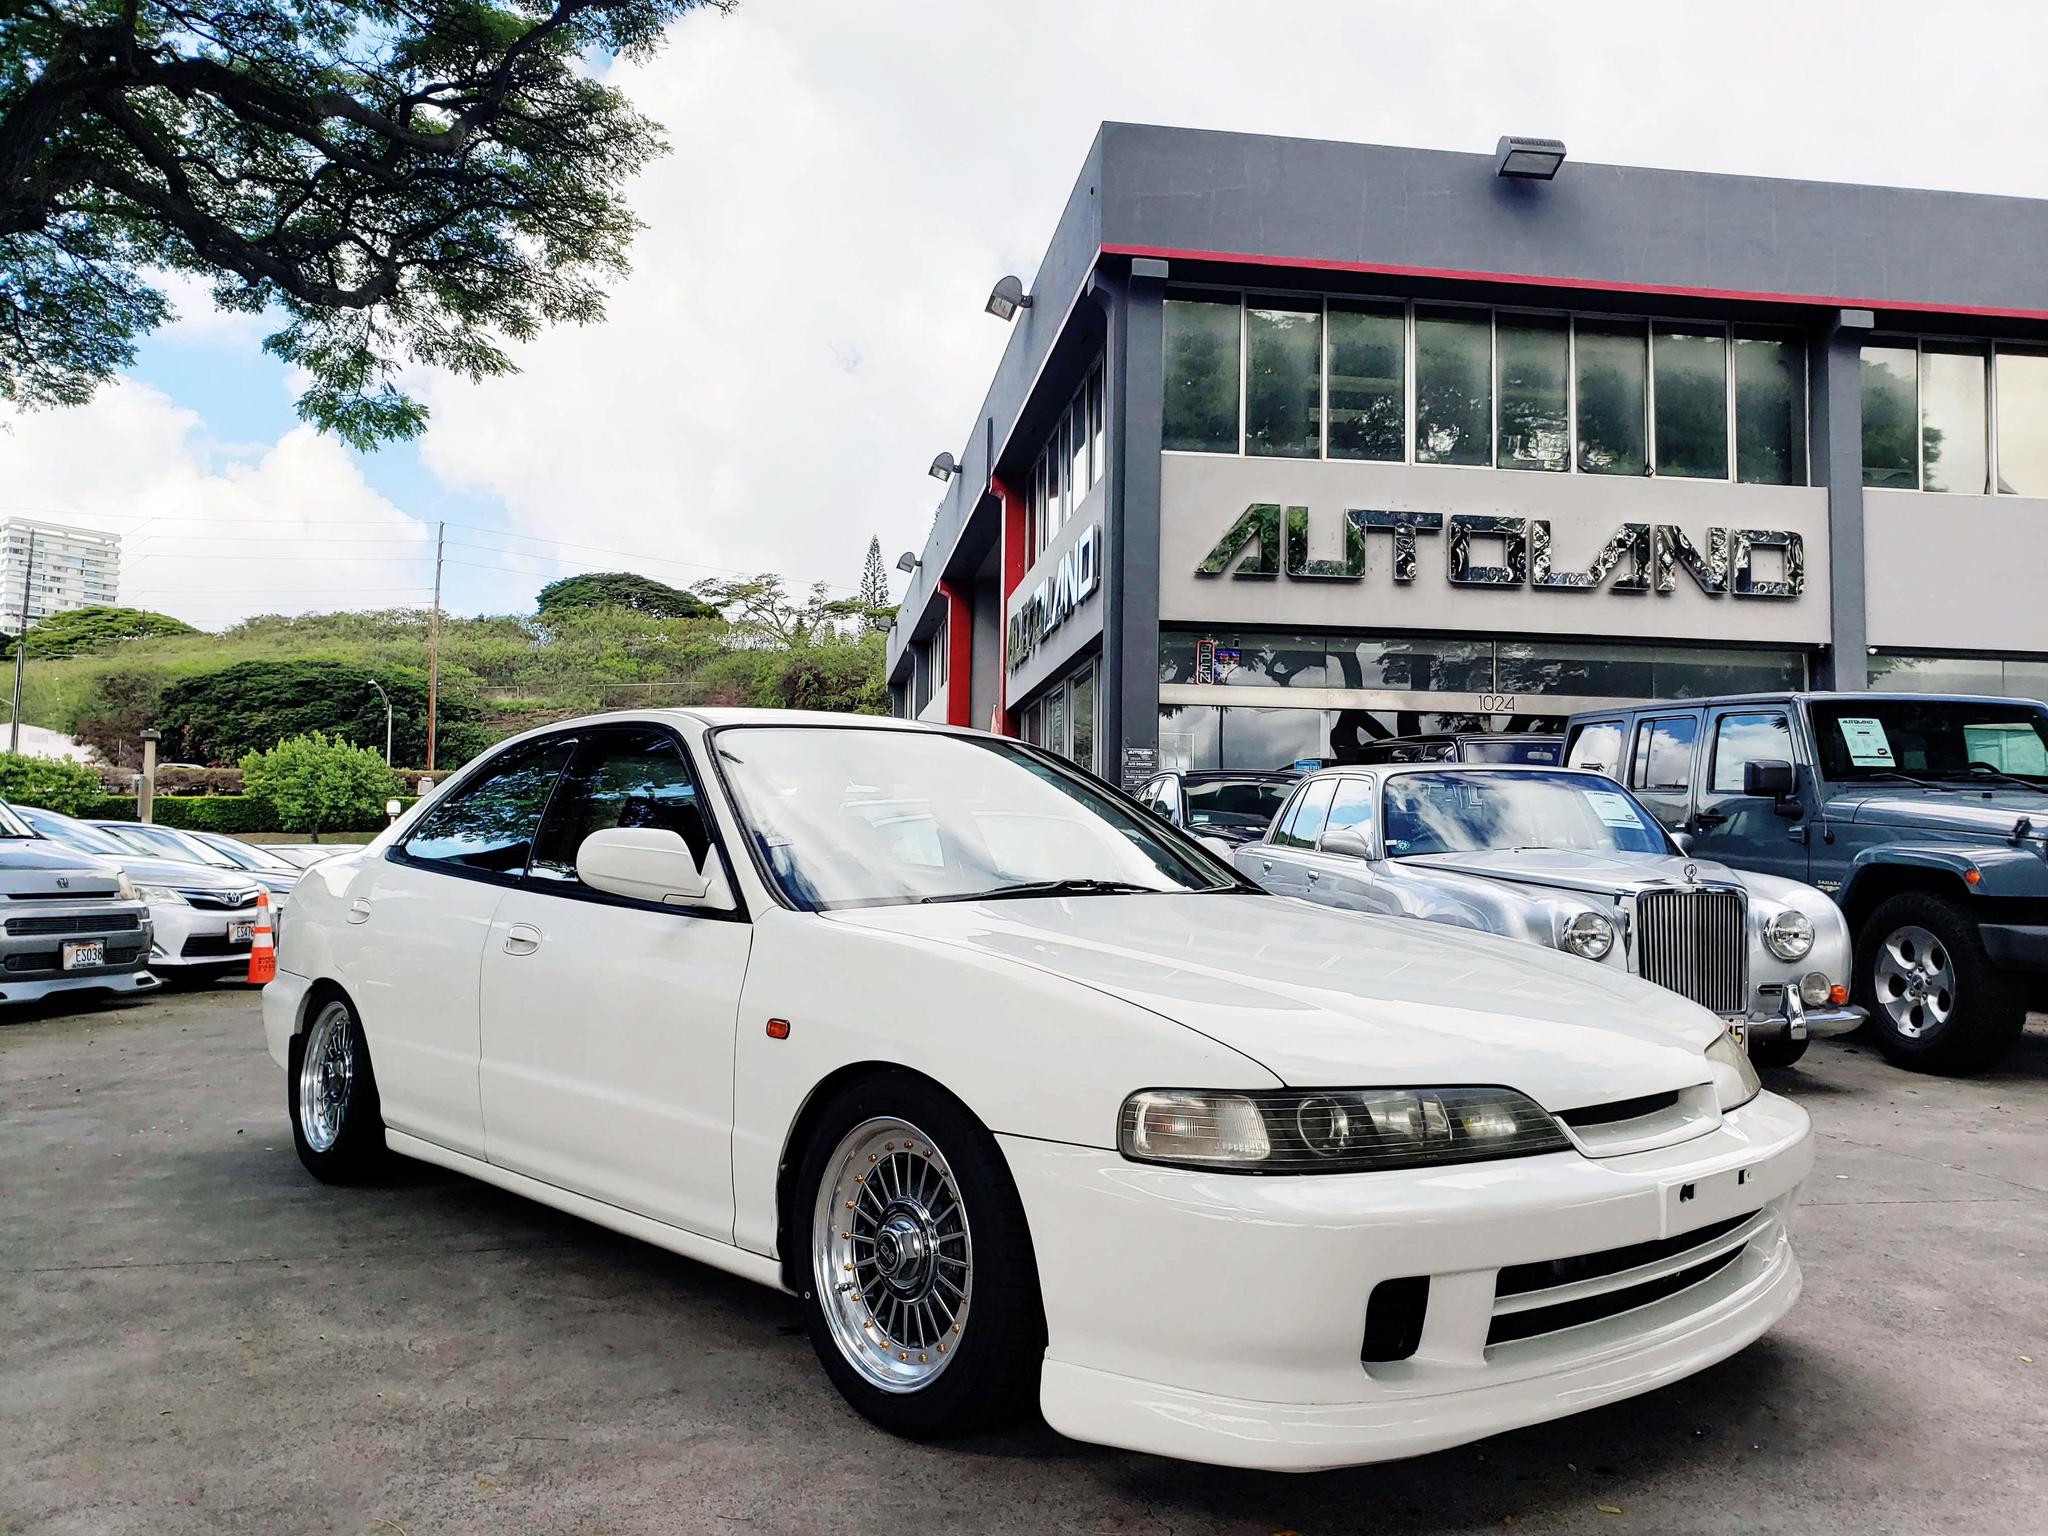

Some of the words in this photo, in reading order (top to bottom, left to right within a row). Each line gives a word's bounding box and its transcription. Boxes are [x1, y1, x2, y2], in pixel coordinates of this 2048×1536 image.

[1194, 503, 1804, 600] AUTOLAND
[1478, 694, 1515, 712] 1024
[75, 947, 103, 963] ES038
